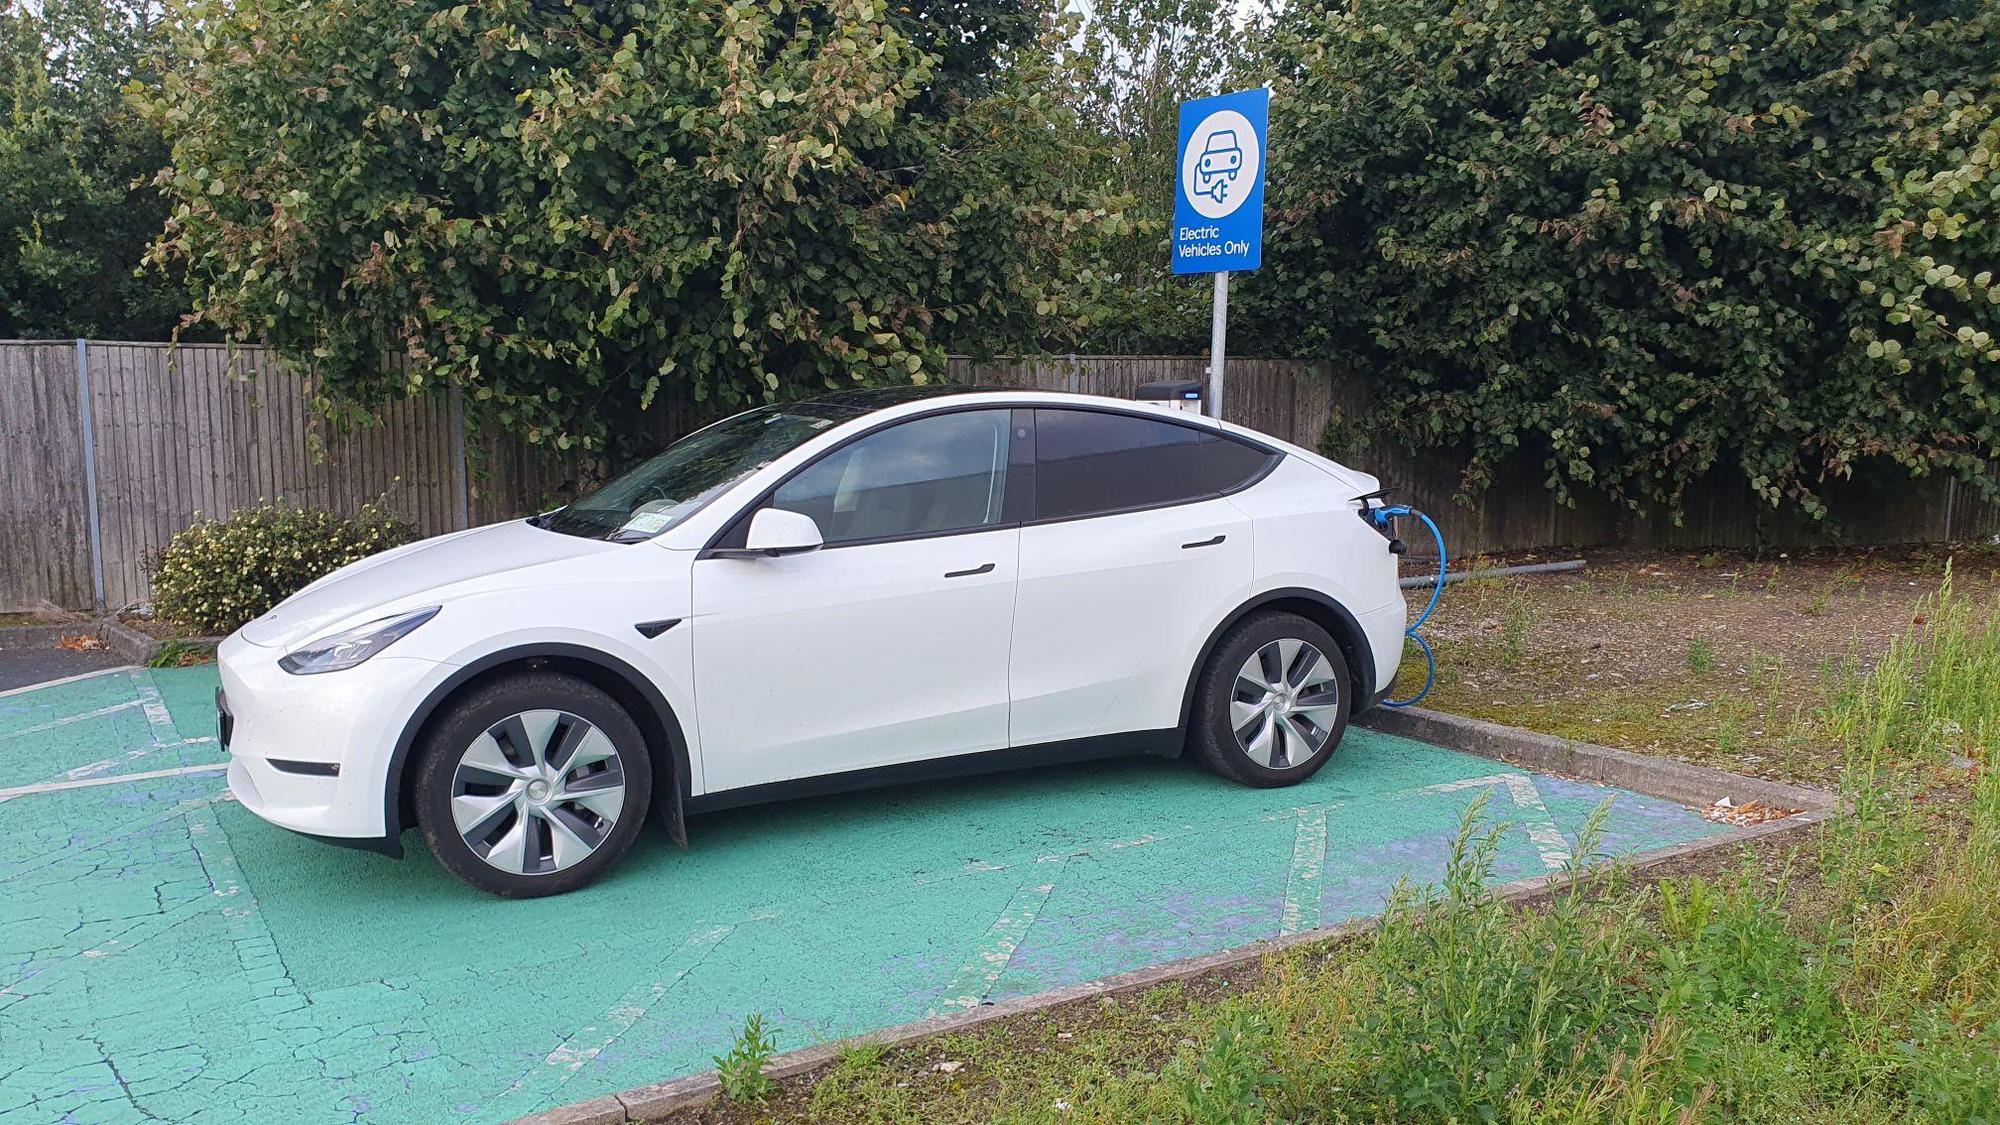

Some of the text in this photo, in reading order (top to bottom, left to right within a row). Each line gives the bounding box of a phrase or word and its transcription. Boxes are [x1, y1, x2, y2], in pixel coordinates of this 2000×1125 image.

[1179, 225, 1219, 240] Electric
[1178, 240, 1250, 258] Vehicles Only
